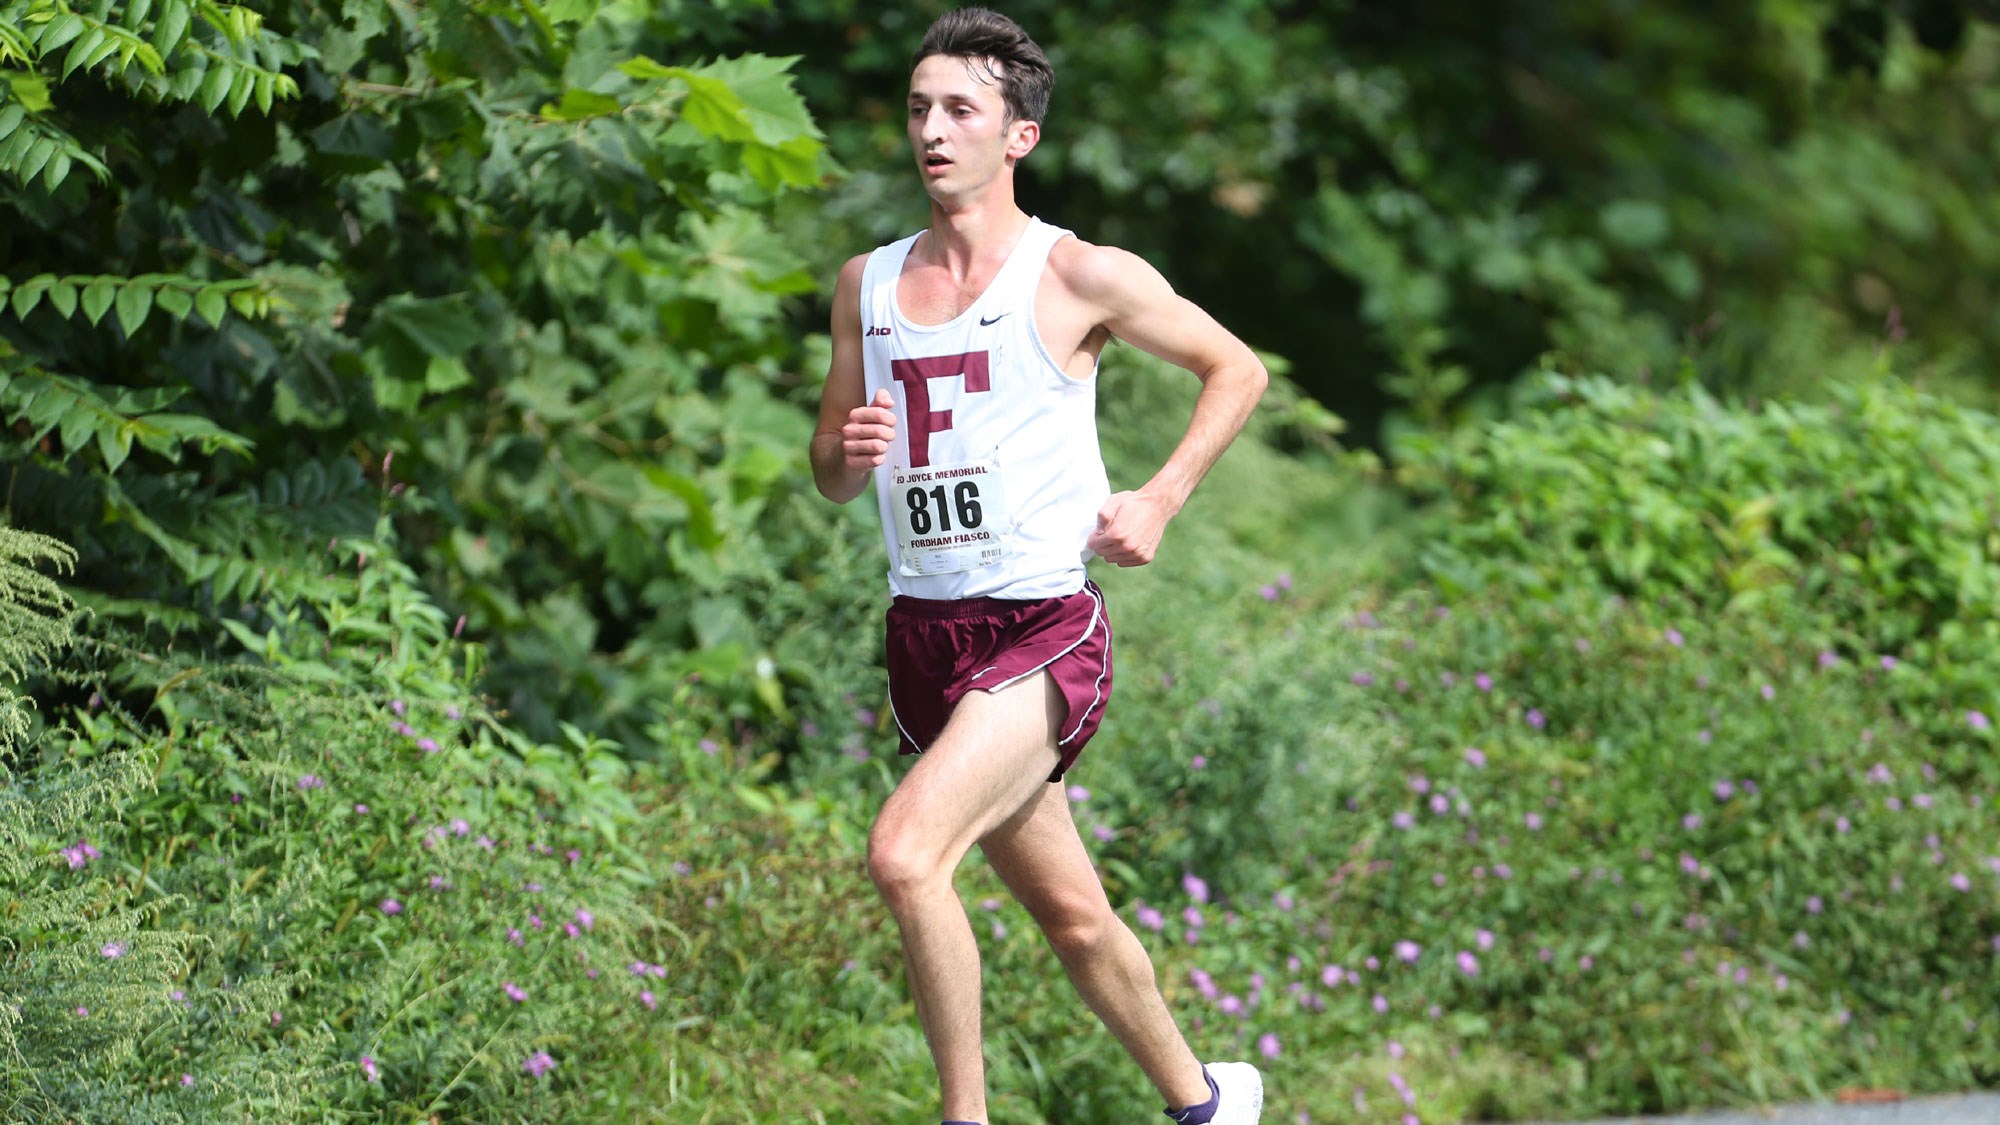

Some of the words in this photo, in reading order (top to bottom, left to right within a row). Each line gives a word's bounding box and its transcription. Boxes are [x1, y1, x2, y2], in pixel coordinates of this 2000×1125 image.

[891, 350, 990, 468] F
[906, 473, 932, 483] JOYCE
[935, 466, 988, 479] MEMORIAL
[906, 481, 983, 535] 816
[911, 536, 952, 548] FORDHAM
[954, 531, 990, 543] FIASCO
